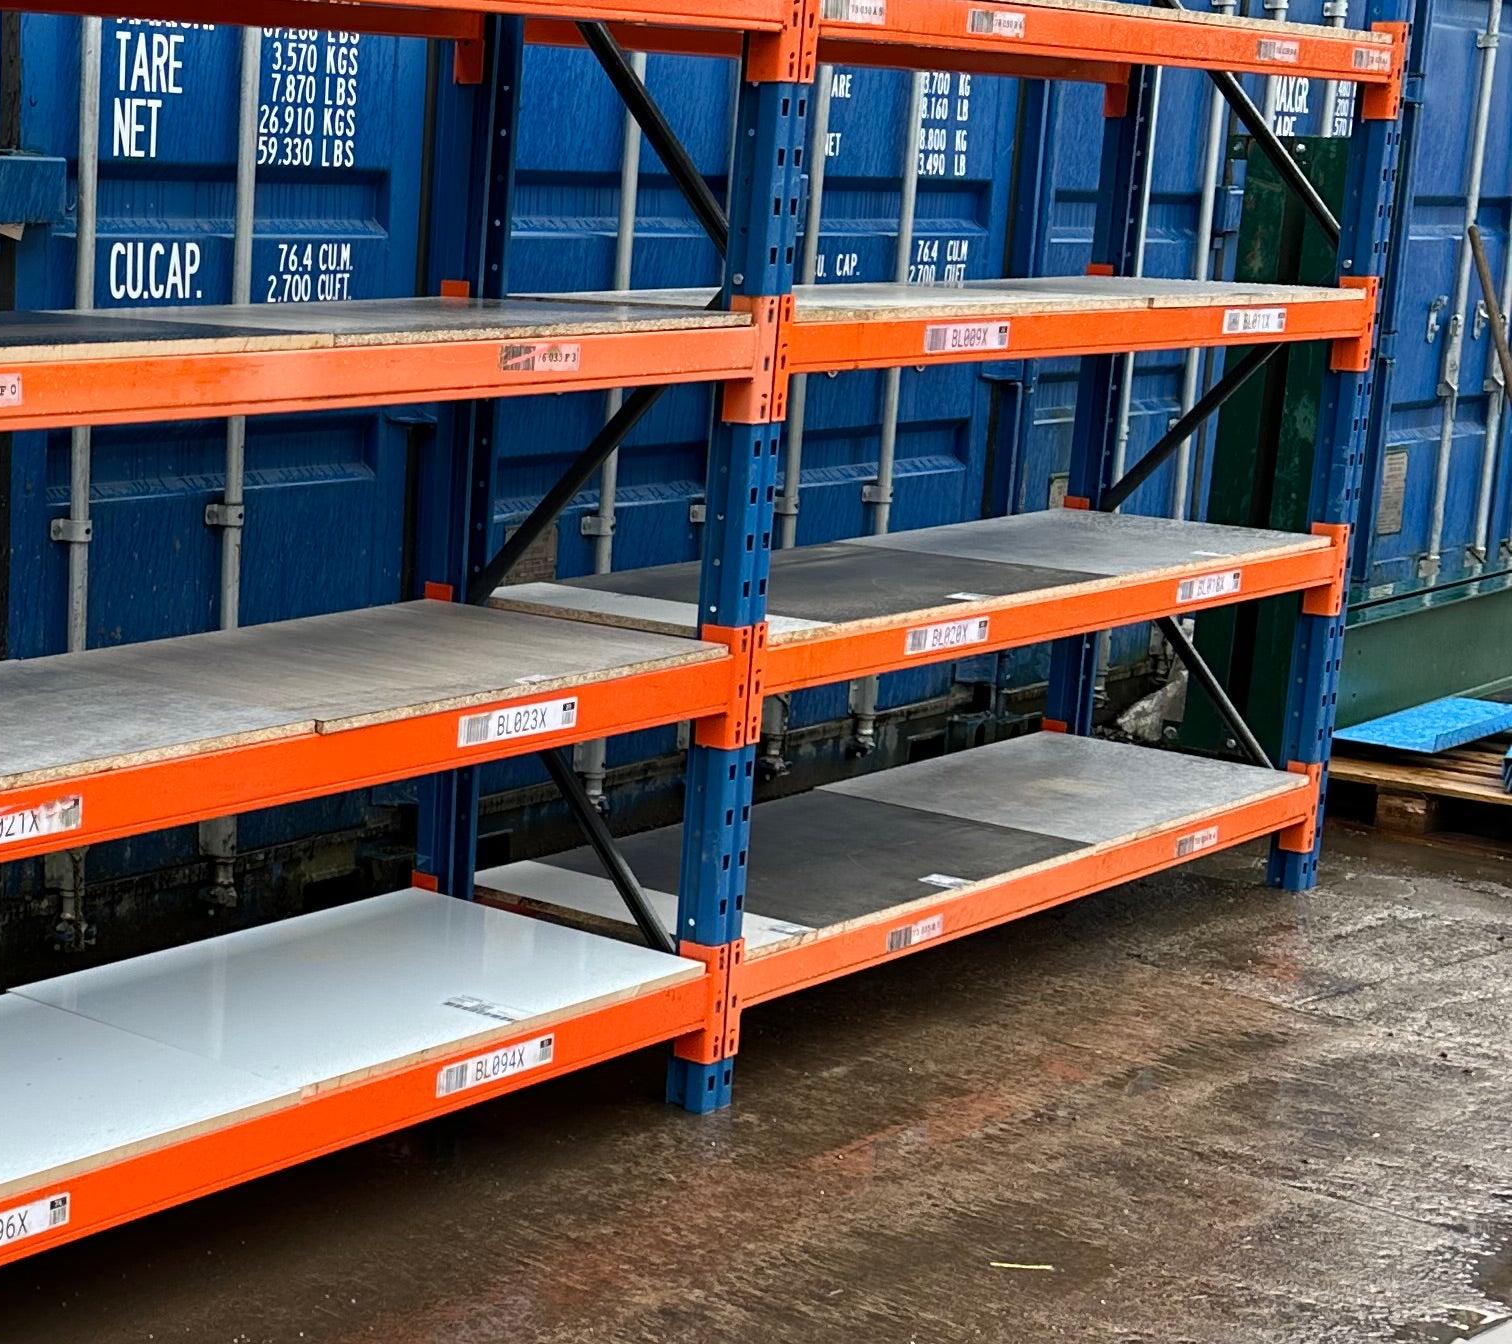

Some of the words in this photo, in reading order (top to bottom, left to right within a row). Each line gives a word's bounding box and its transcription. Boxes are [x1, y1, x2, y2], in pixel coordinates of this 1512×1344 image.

[116, 31, 184, 94] TARE
[326, 46, 358, 75] KGS
[325, 77, 356, 106] LBS
[831, 74, 853, 99] ARE
[958, 75, 971, 96] KG
[323, 108, 355, 137] KGS
[957, 98, 969, 121] LB
[113, 97, 162, 157] NET
[955, 130, 968, 152] KG
[322, 139, 354, 168] LBS
[954, 154, 966, 176] LB
[278, 244, 312, 272] 76.4
[836, 253, 860, 277] CAP.
[497, 707, 548, 736] BL023X
[475, 1046, 525, 1081] BL094X
